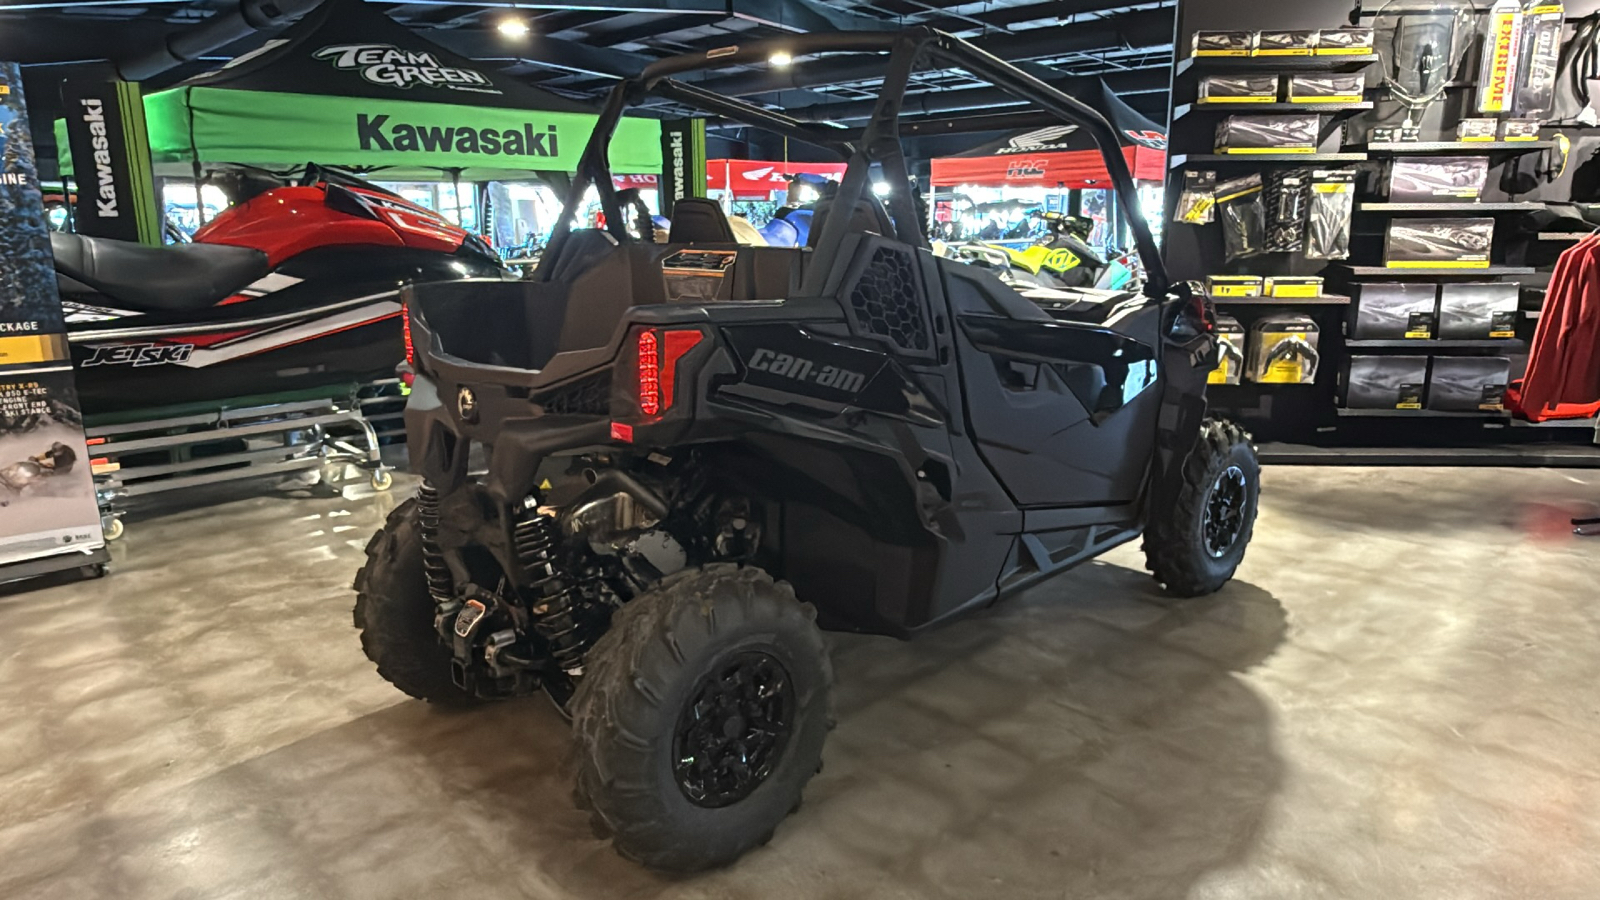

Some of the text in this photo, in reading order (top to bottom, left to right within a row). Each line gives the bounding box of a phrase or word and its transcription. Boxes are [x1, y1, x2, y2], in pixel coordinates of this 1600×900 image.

[316, 45, 439, 68] TEAM
[364, 63, 486, 87] GREEN
[1492, 19, 1514, 105] EXTREME
[356, 114, 559, 157] Kawasaki
[994, 143, 1068, 154] HONDA
[81, 99, 119, 218] Kawasaki
[669, 131, 684, 201] awasaki
